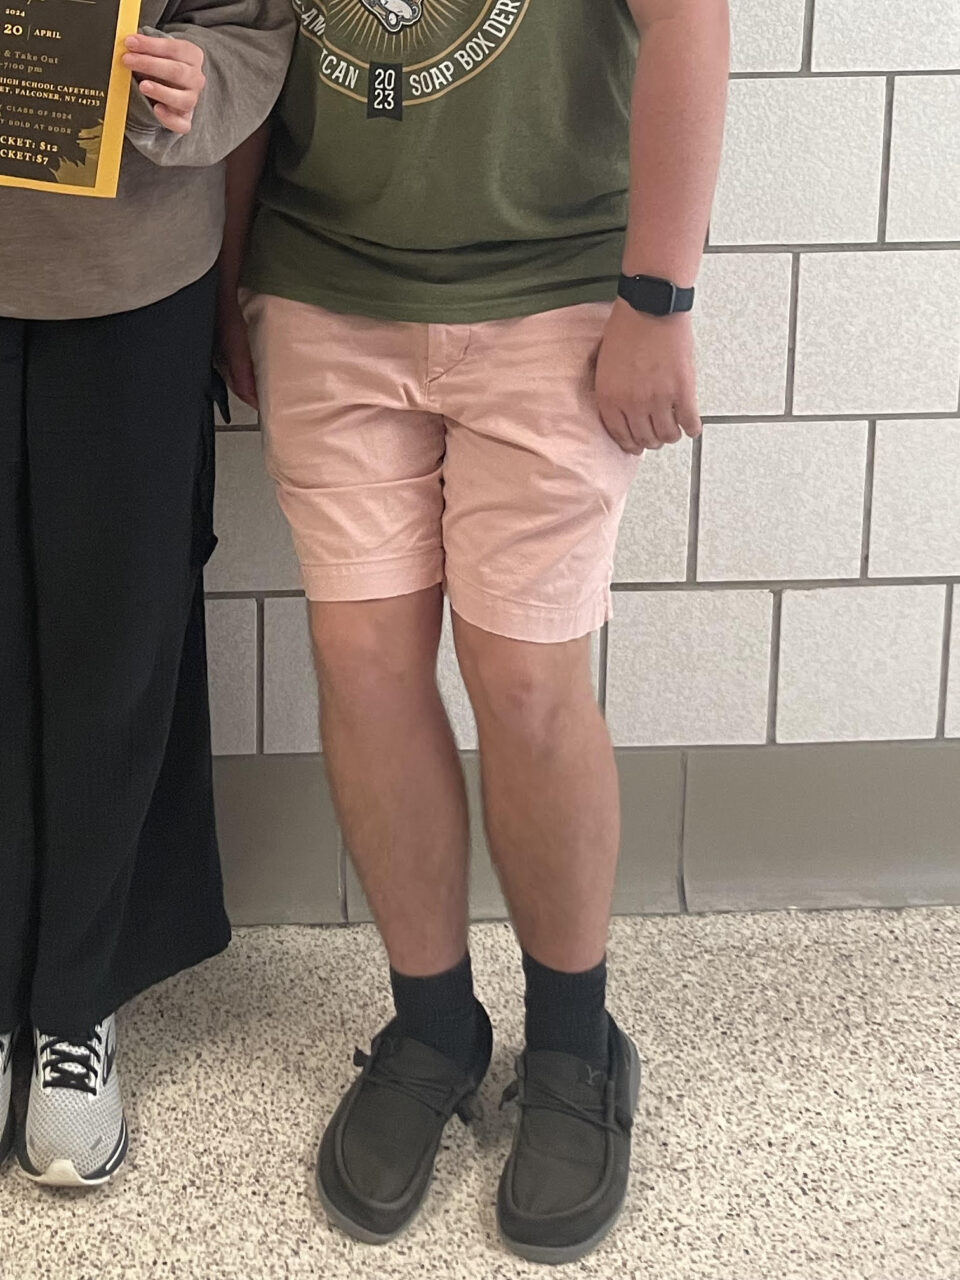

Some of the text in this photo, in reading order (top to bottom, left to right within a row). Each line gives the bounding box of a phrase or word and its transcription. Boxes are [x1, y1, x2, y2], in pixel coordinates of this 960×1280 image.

[5, 8, 25, 17] 2024
[3, 24, 23, 35] 20
[34, 28, 62, 39] APRIL
[4, 49, 12, 58] &
[15, 51, 38, 62] Take
[41, 54, 59, 64] Out
[28, 64, 43, 74] pm
[409, 67, 454, 97] SOAP
[454, 36, 497, 73] BOX
[375, 69, 394, 90] 20
[16, 88, 62, 101] FALCONER,
[22, 80, 55, 92] SCHOOL
[57, 85, 105, 97] CAFETERIA
[374, 90, 394, 109] 23
[7, 105, 34, 115] CLASS
[52, 111, 72, 120] 2024
[8, 120, 31, 129] SOLD
[39, 141, 57, 152] $12
